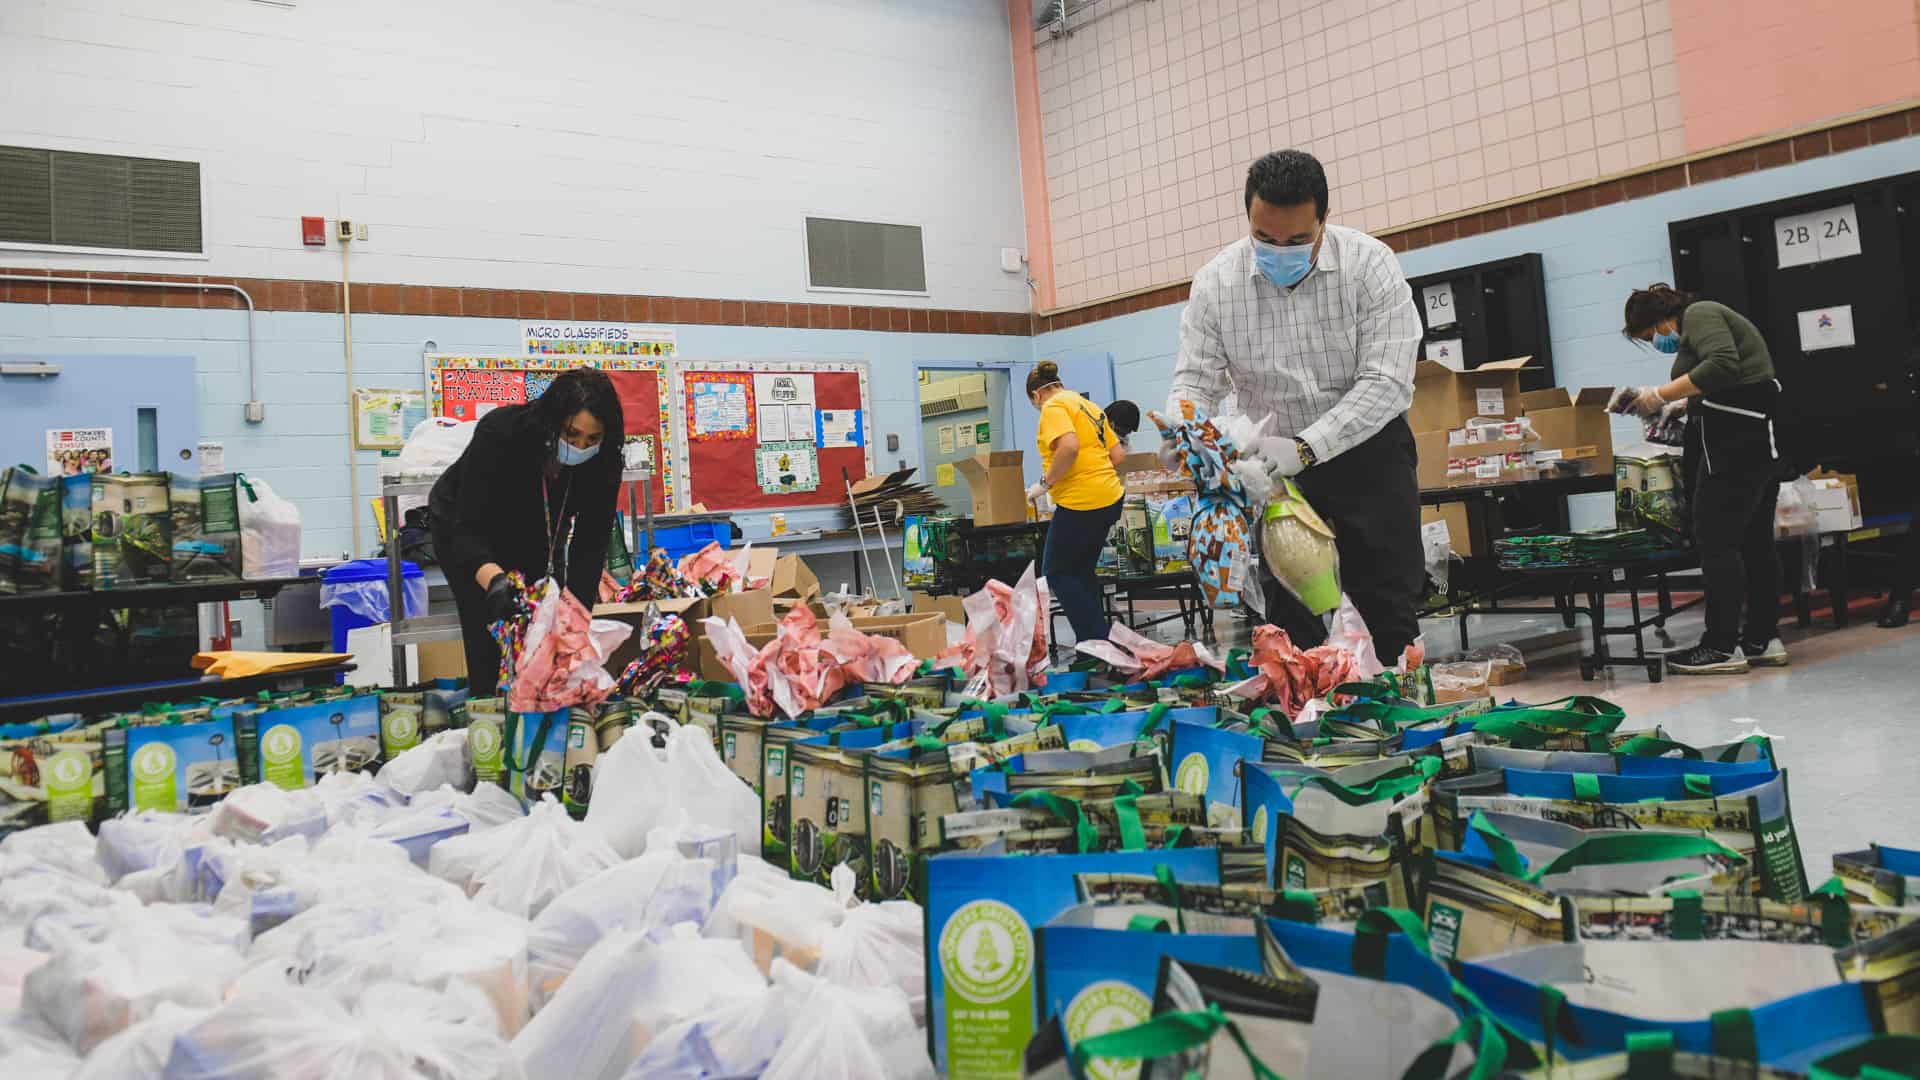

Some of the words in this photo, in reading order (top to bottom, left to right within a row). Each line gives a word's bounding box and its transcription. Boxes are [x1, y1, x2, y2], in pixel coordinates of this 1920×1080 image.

[1783, 226, 1810, 246] 2B
[1823, 217, 1852, 239] 2A
[1430, 292, 1449, 310] 2C
[527, 327, 561, 339] MICRO
[563, 327, 628, 340] CLASSIFIEDS
[453, 369, 513, 386] MICRO
[444, 385, 520, 401] TRAVELS
